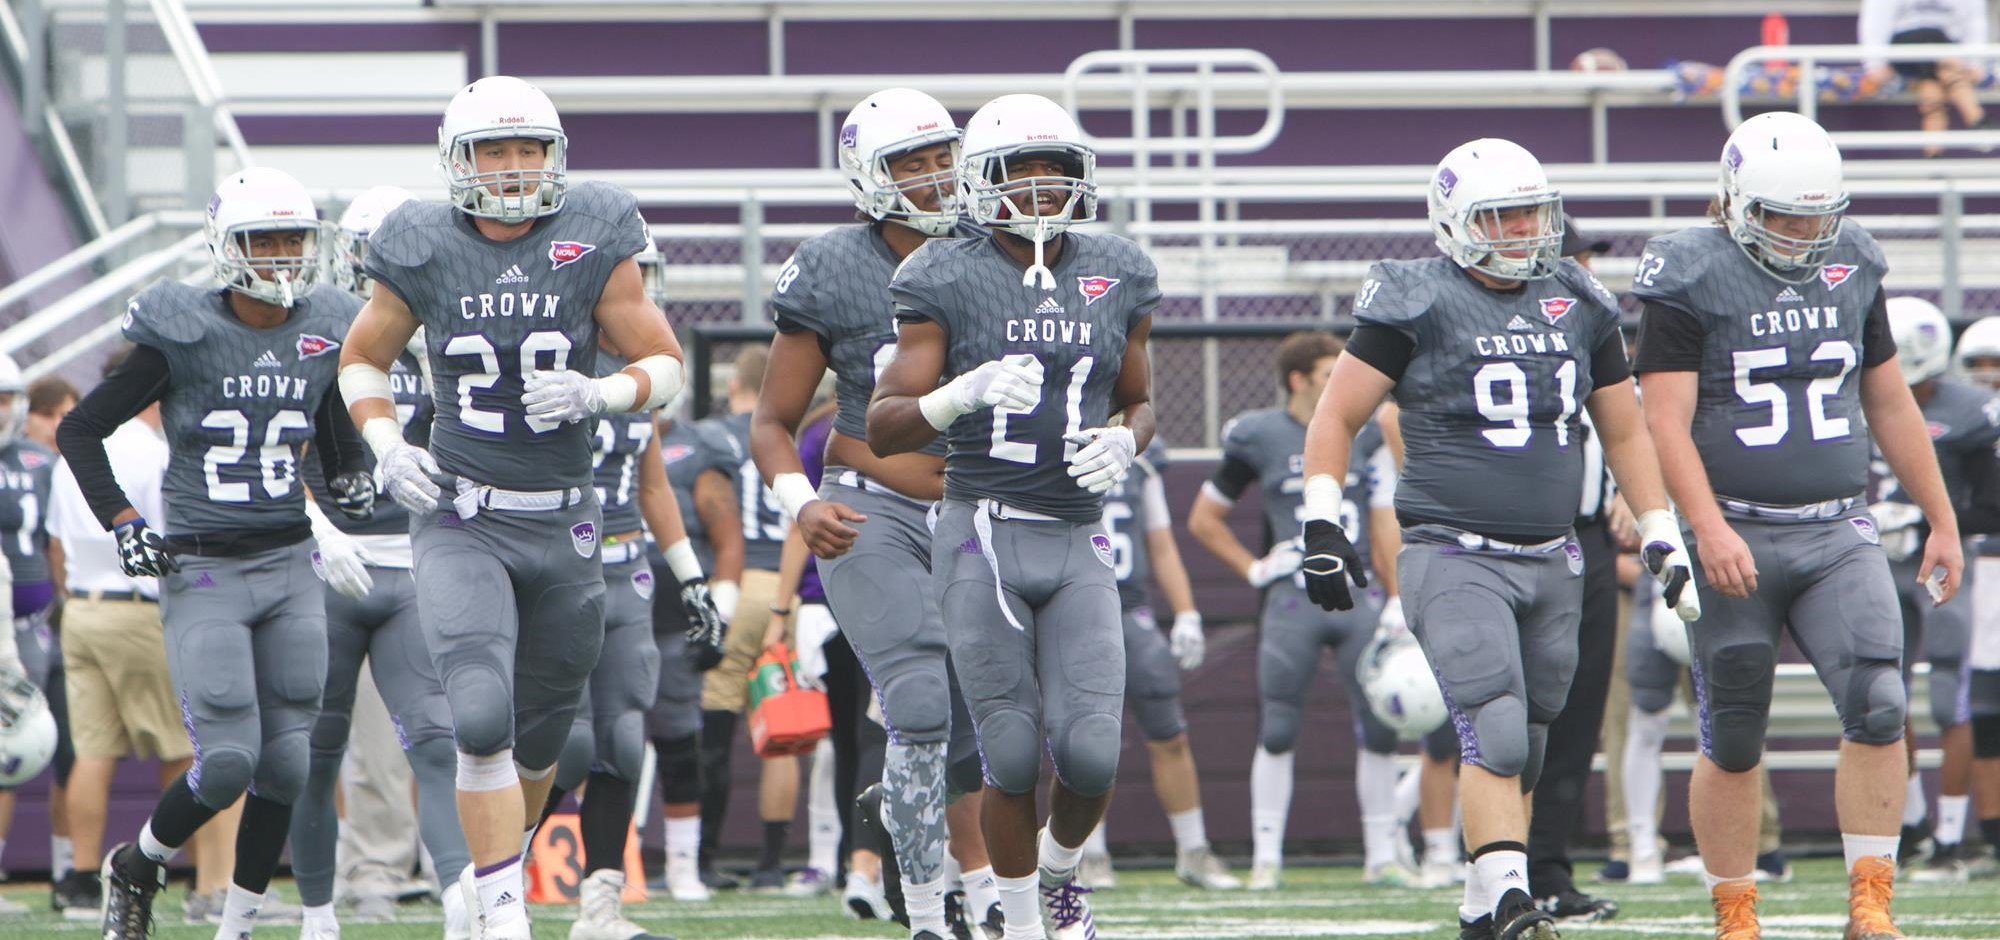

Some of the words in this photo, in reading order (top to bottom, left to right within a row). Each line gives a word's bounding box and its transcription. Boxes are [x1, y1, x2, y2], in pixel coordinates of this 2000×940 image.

[496, 274, 529, 284] adidas
[460, 292, 561, 320] CROWN
[1035, 305, 1065, 314] adidas
[1006, 319, 1092, 346] CROWN
[1751, 306, 1839, 337] CROWN
[1475, 332, 1569, 357] CROWN
[222, 375, 308, 401] CROWN
[1732, 340, 1857, 447] 52
[989, 353, 1094, 464] 21
[1473, 360, 1578, 447] 91
[201, 409, 309, 502] 26
[548, 824, 585, 898] 3
